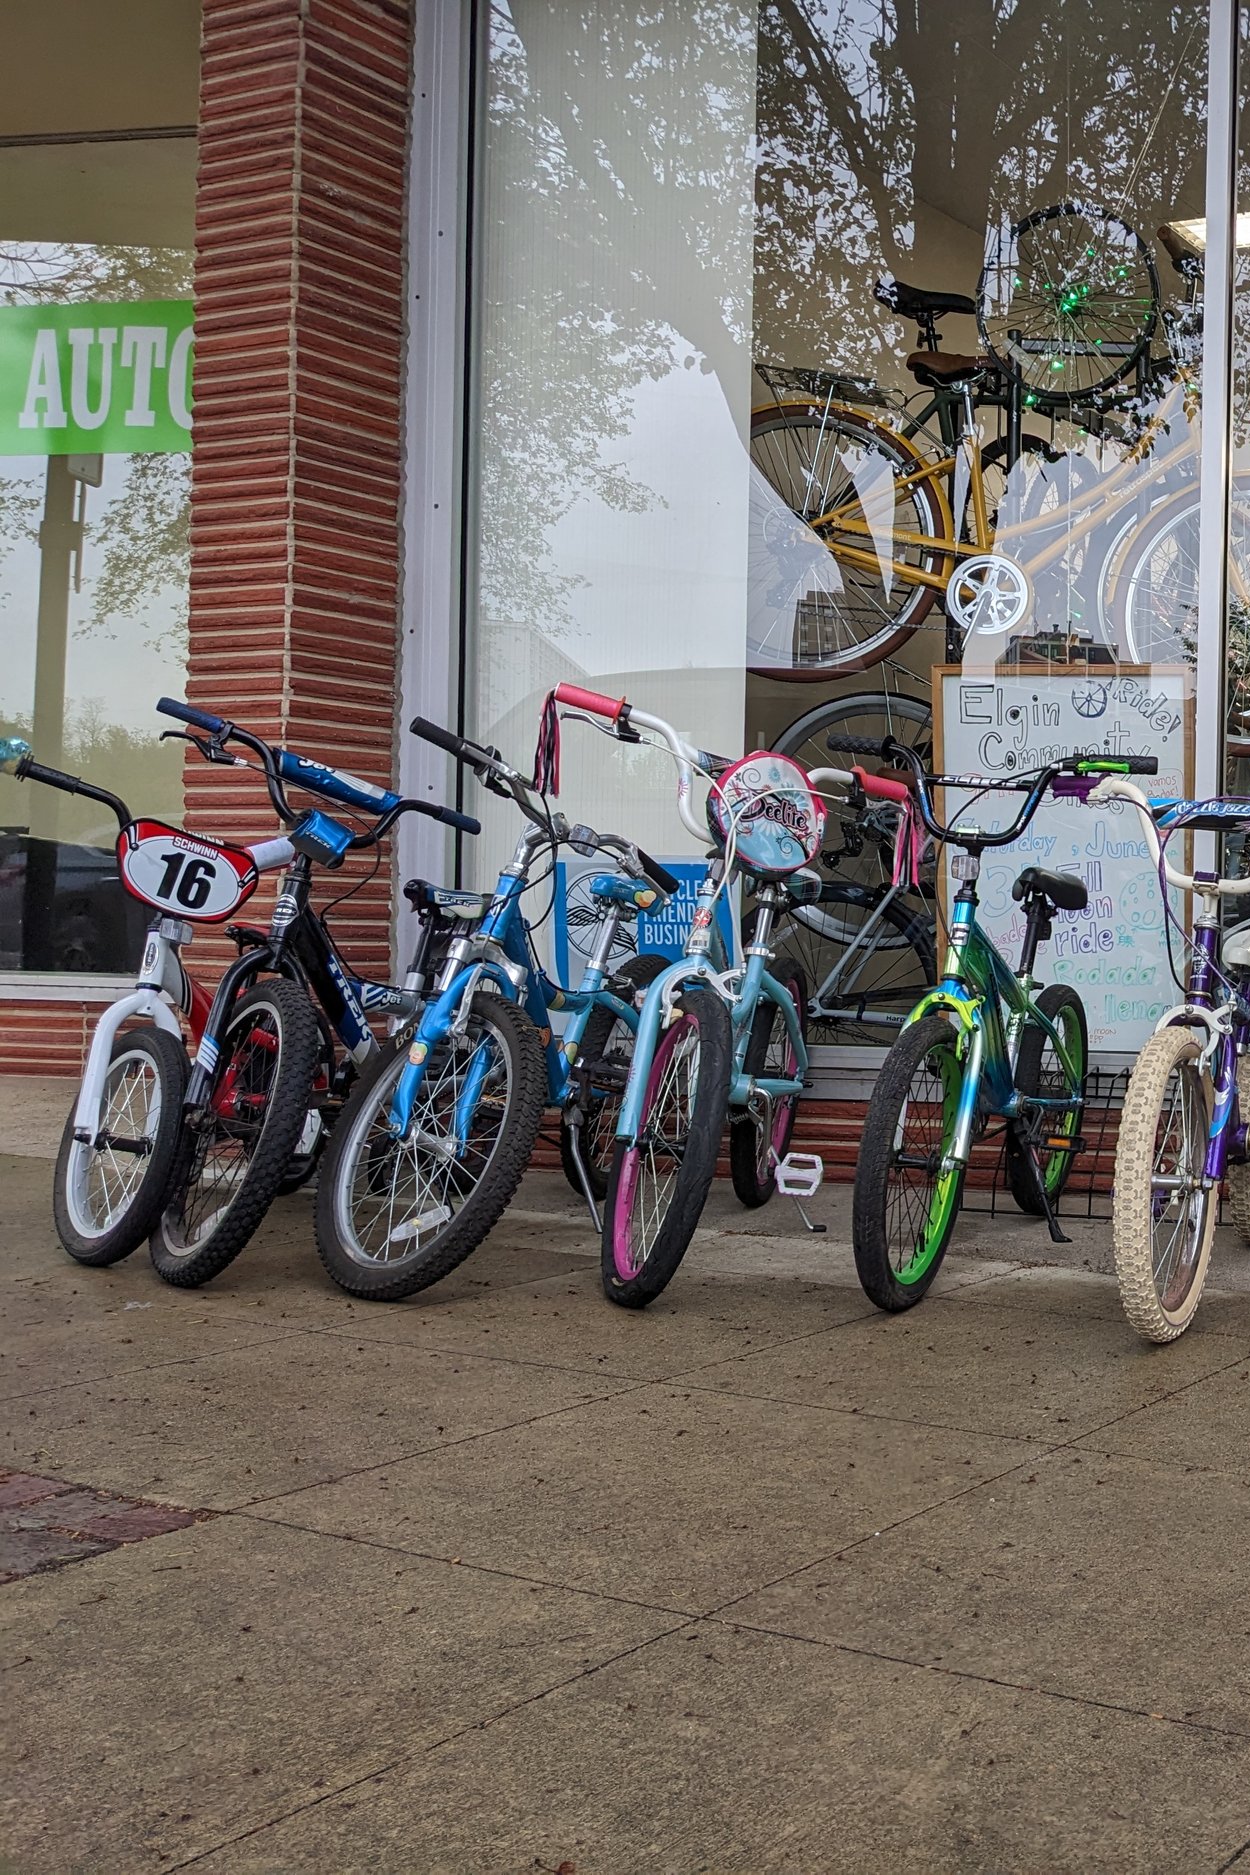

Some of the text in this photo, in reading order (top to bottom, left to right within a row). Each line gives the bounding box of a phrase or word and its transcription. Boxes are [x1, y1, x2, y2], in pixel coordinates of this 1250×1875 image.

[960, 684, 1060, 750] Elgin
[172, 835, 219, 860] SCHWINN
[1085, 820, 1150, 859] June
[156, 851, 217, 909] 16
[644, 924, 691, 945] BUSIN
[1055, 922, 1114, 956] ride
[1053, 955, 1157, 985] Rodada
[328, 953, 373, 1042] TREK
[380, 990, 402, 1006] Jet
